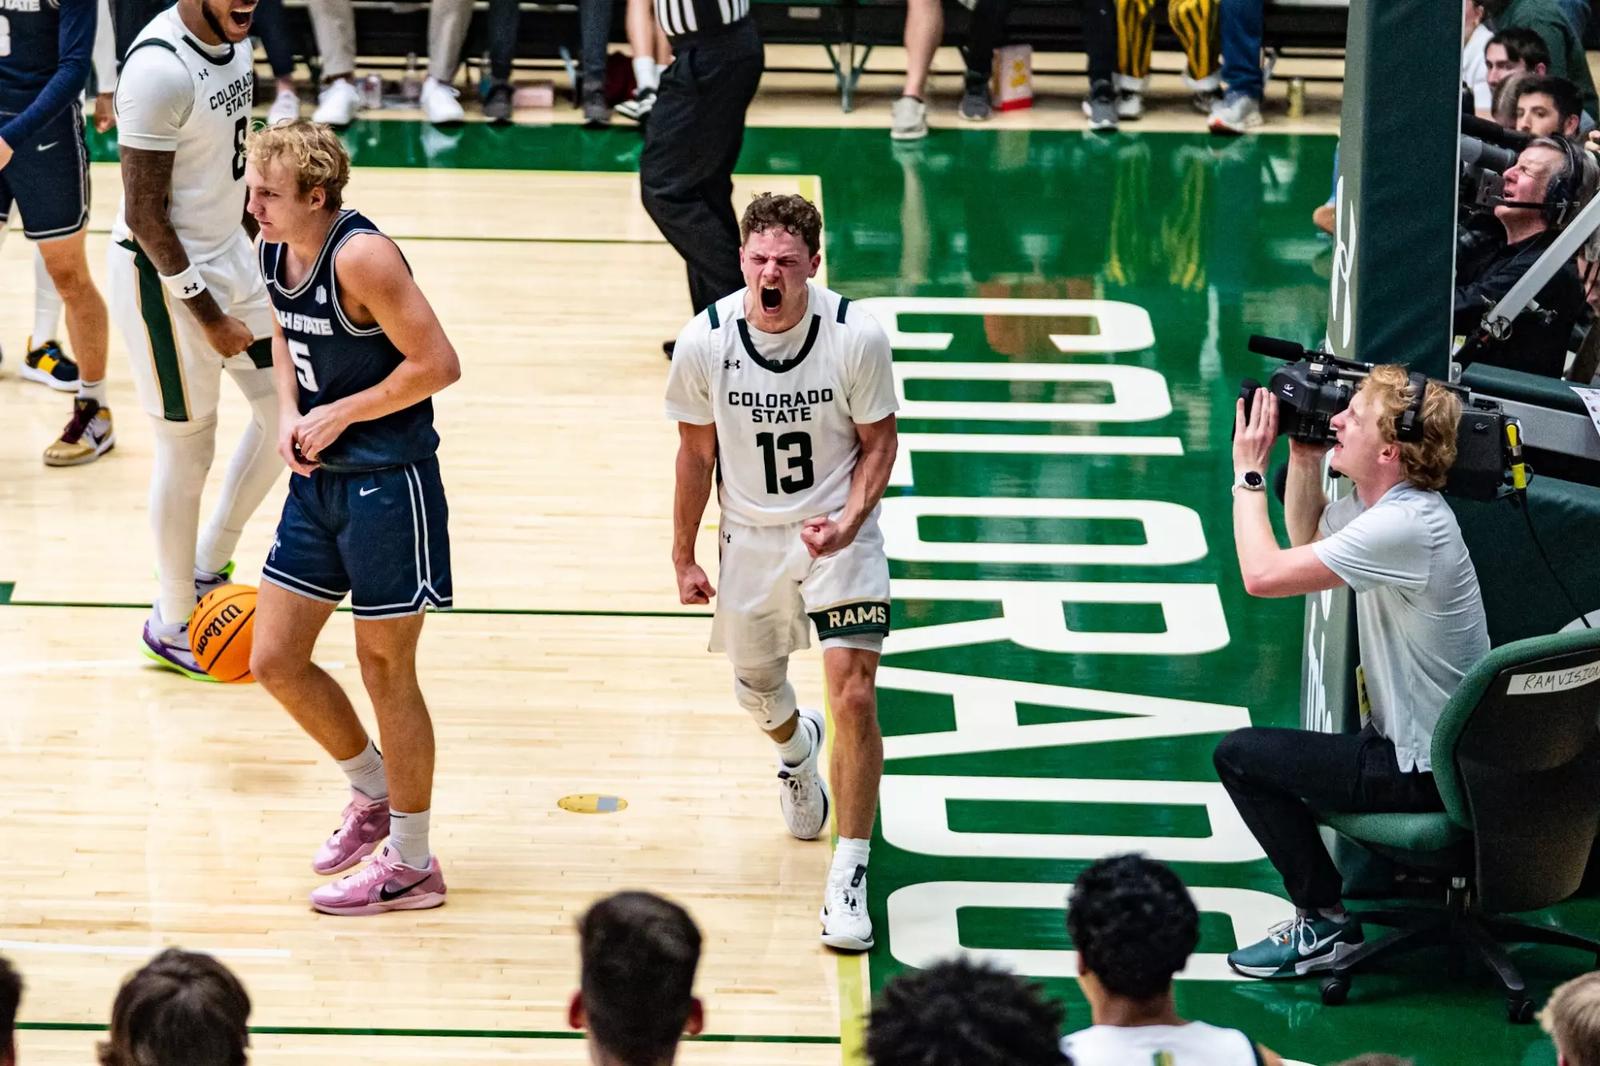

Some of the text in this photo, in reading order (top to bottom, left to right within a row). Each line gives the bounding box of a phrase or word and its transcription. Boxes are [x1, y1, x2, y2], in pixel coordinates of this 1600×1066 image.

[225, 89, 252, 117] STATE
[293, 312, 334, 336] STATE
[287, 338, 320, 393] 5
[728, 388, 833, 409] COLORADO
[751, 406, 812, 424] STATE
[755, 431, 814, 495] 13
[196, 603, 244, 657] Wilson
[827, 605, 887, 629] RAMS
[856, 297, 1296, 982] COLORADO
